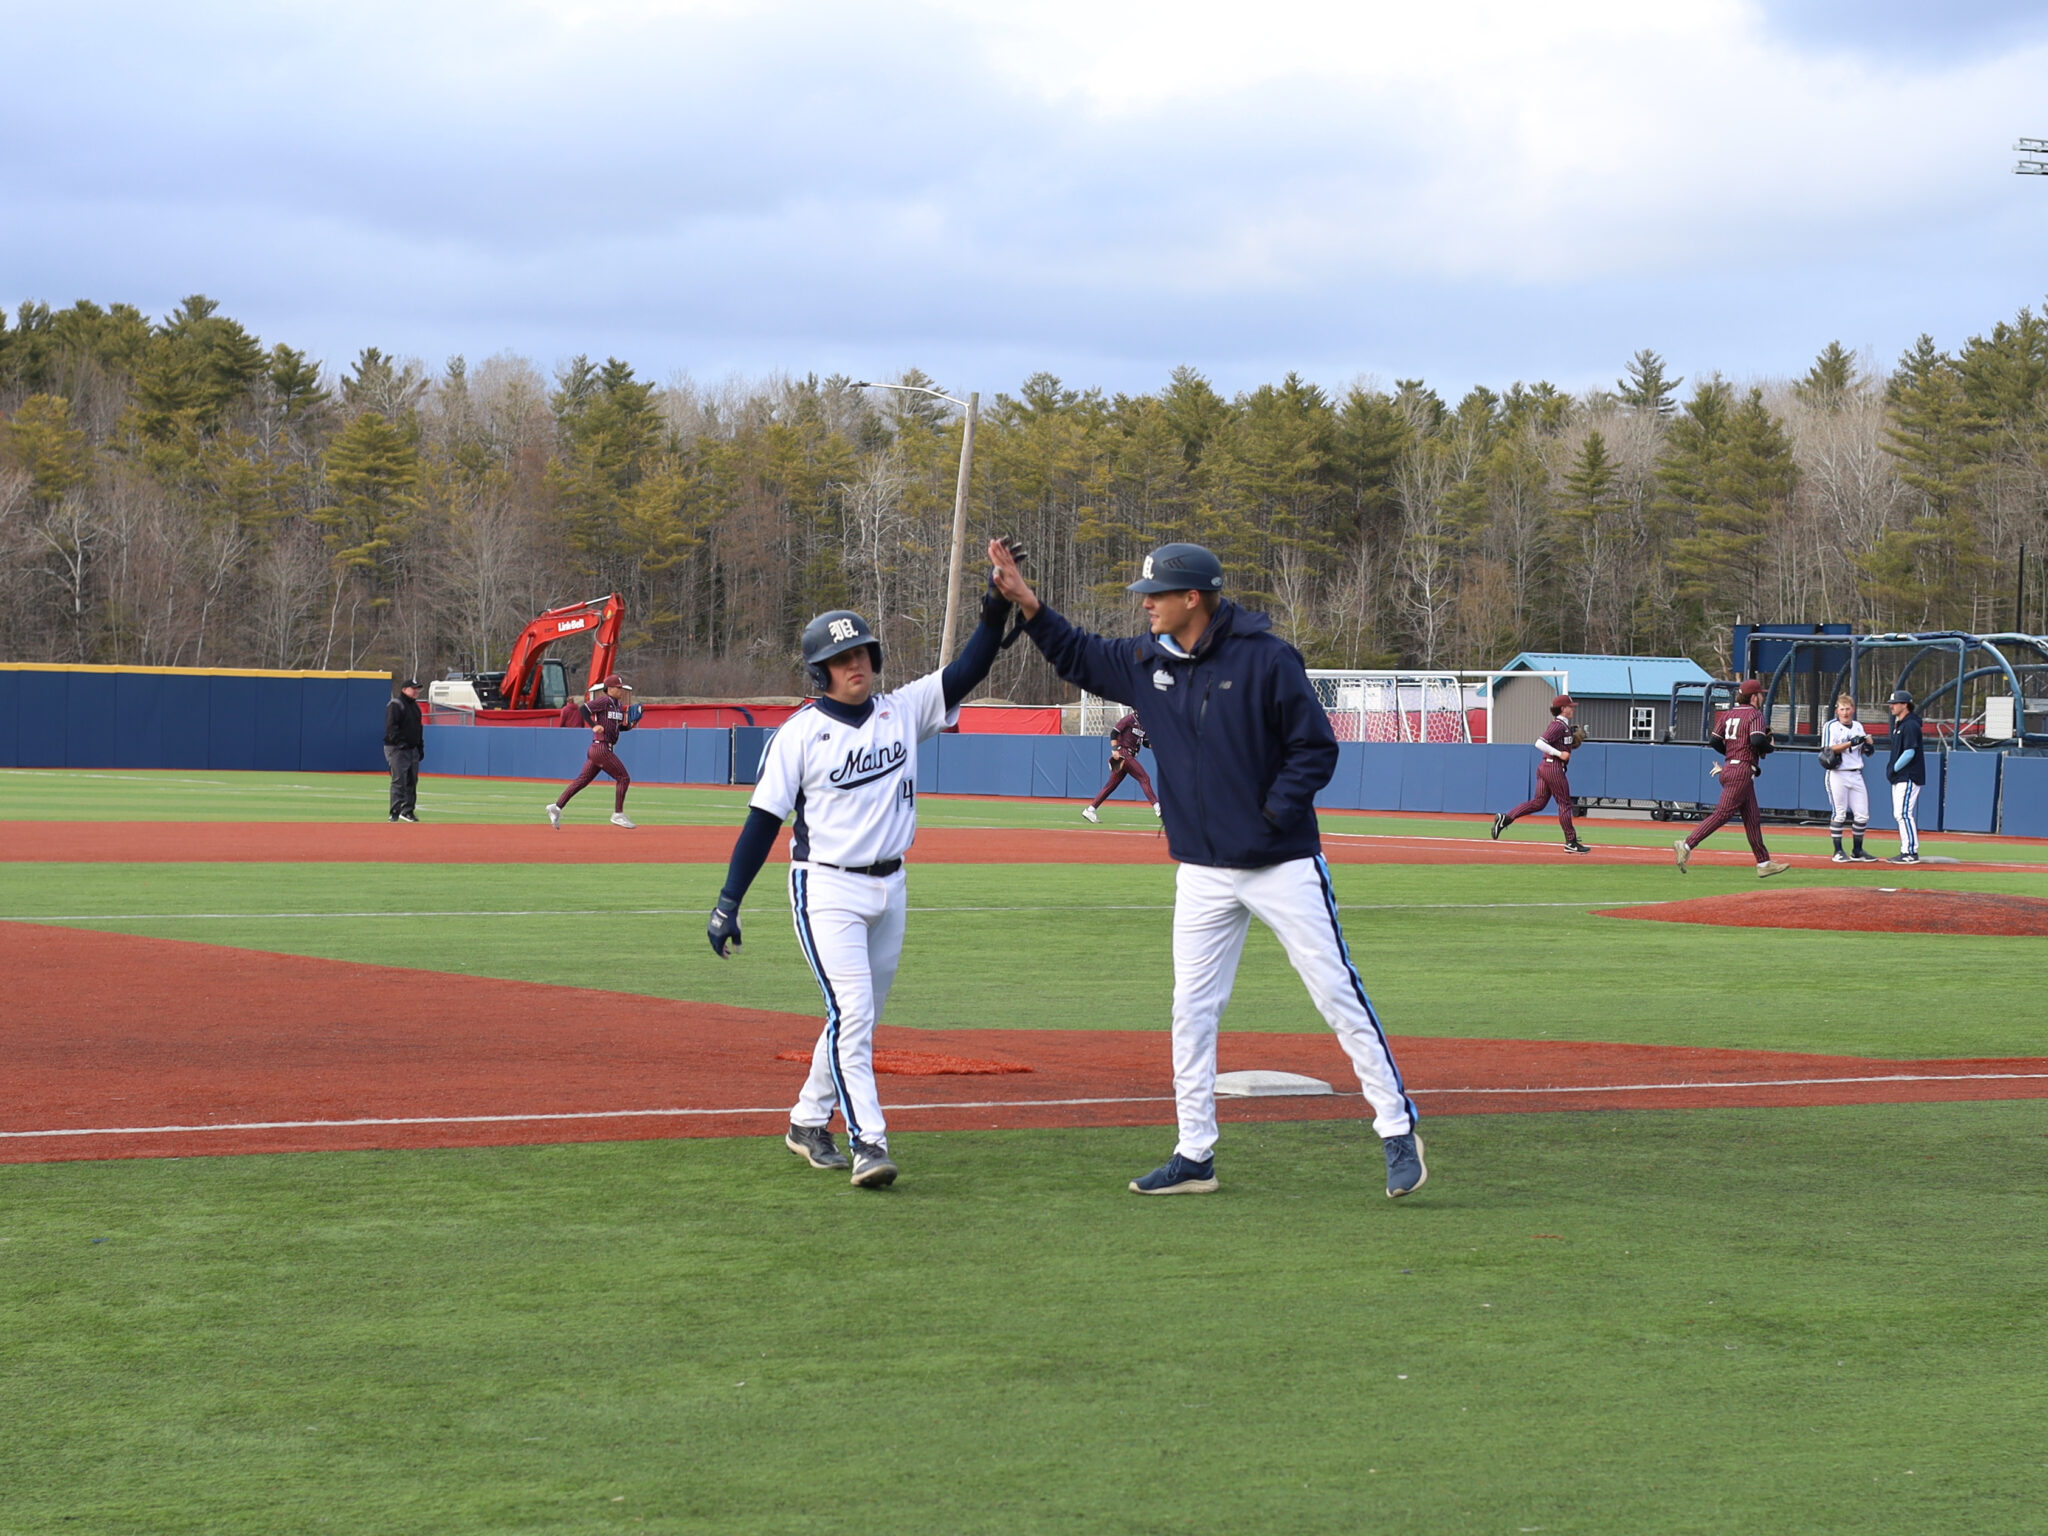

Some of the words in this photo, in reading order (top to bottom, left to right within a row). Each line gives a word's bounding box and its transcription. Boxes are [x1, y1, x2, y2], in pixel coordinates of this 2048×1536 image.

[1725, 718, 1740, 739] 17
[829, 741, 907, 783] Maine
[895, 779, 914, 813] 14
